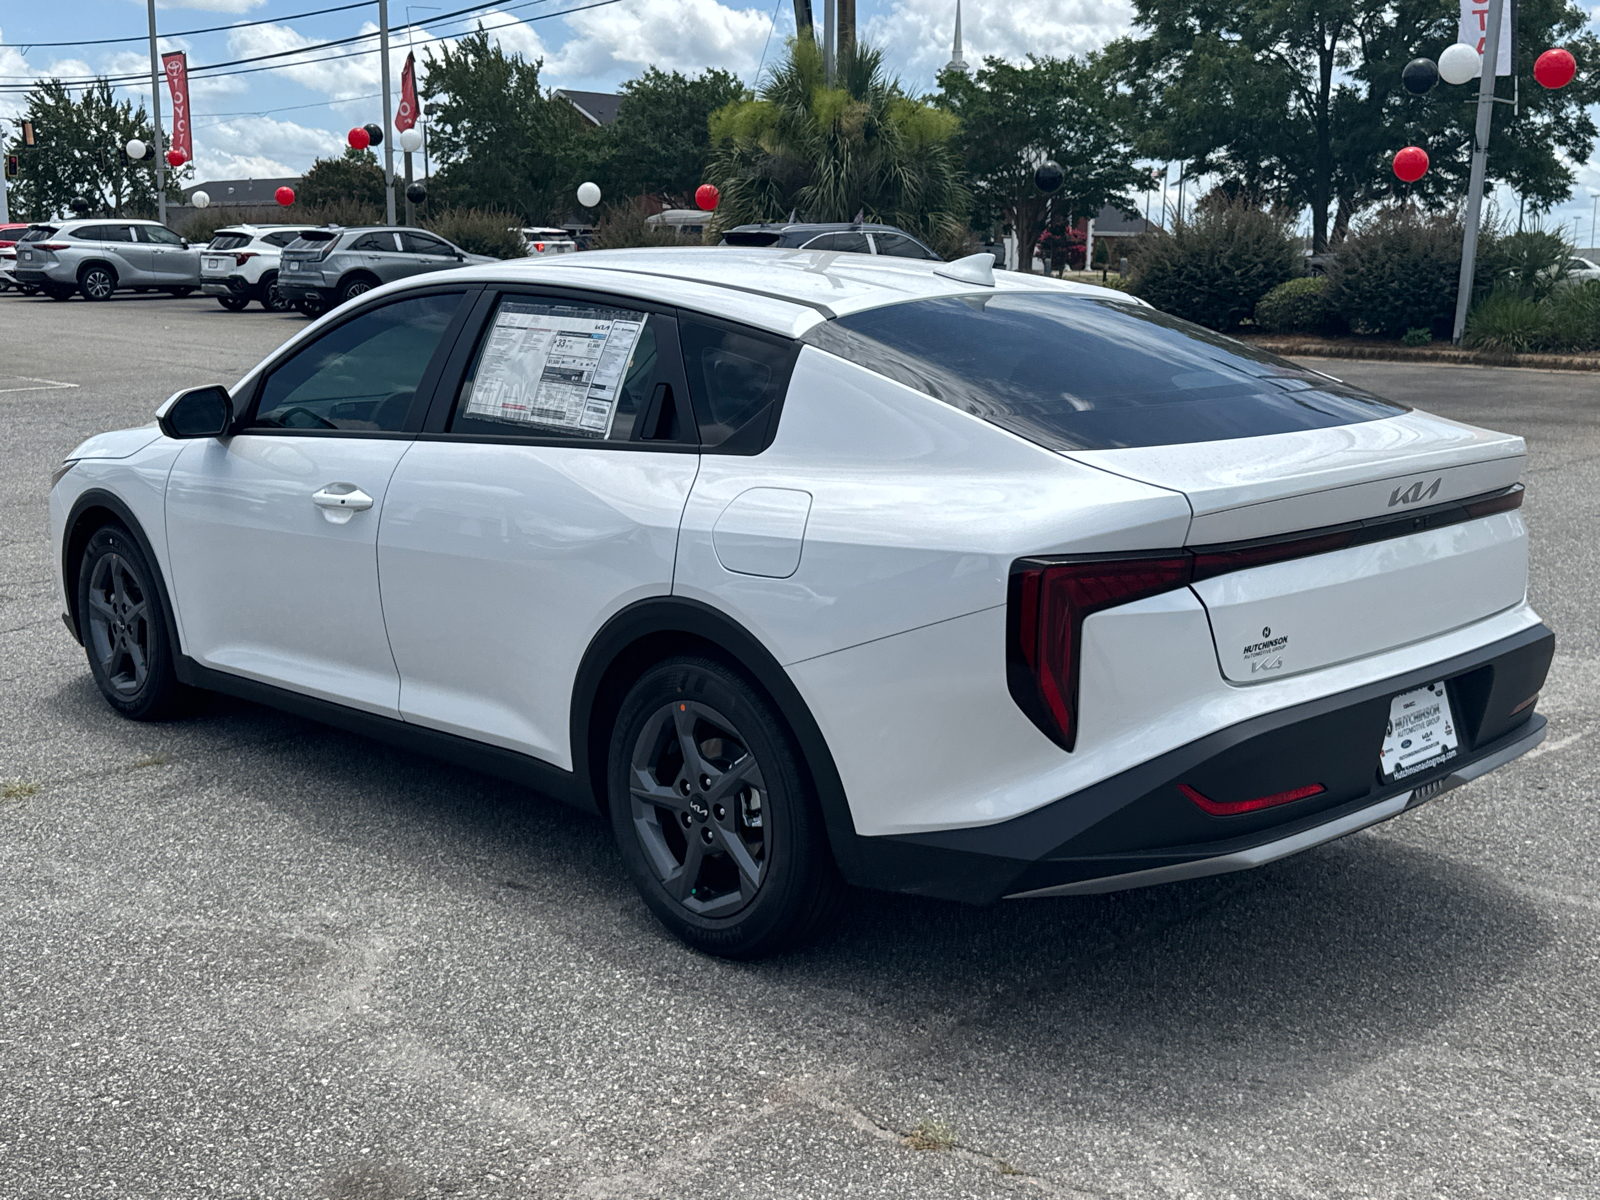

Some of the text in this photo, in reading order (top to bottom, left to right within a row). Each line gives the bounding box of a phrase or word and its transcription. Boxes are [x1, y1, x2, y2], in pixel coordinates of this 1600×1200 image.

[556, 338, 567, 348] 33
[1388, 477, 1442, 507] KIA
[1243, 635, 1288, 654] HUTCHINSON
[1244, 644, 1287, 660] AUTOMOTIVE GROUP
[1394, 703, 1441, 731] HUTCHINSON
[1397, 715, 1441, 738] AUTOMOTIVE GROUP
